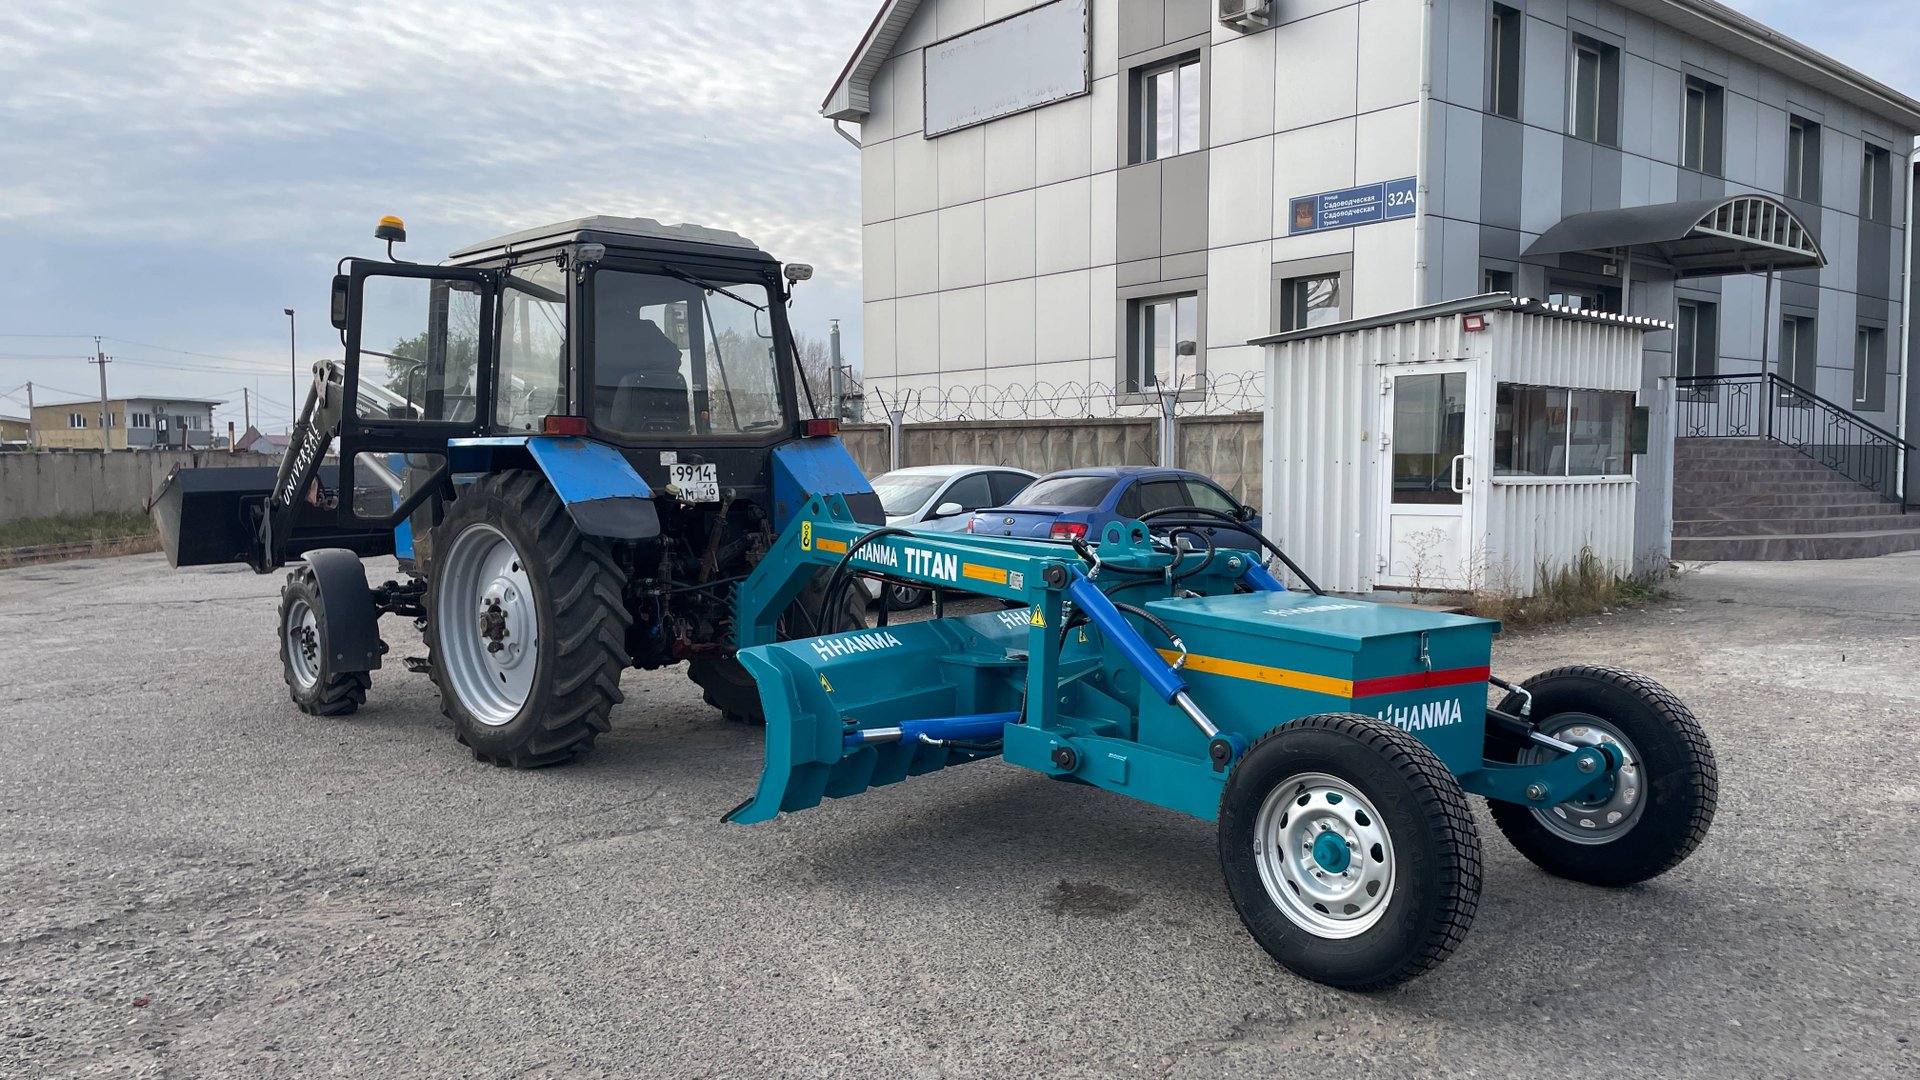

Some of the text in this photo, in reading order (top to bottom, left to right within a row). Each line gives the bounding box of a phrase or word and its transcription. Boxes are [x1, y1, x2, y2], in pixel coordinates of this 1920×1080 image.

[1323, 206, 1375, 219] Садоводческая
[1324, 196, 1375, 209] Садоводческая
[283, 420, 318, 506] UNIVERSAL
[676, 465, 712, 481] 9914
[904, 547, 957, 582] TITAN
[1394, 698, 1462, 732] HANMA
